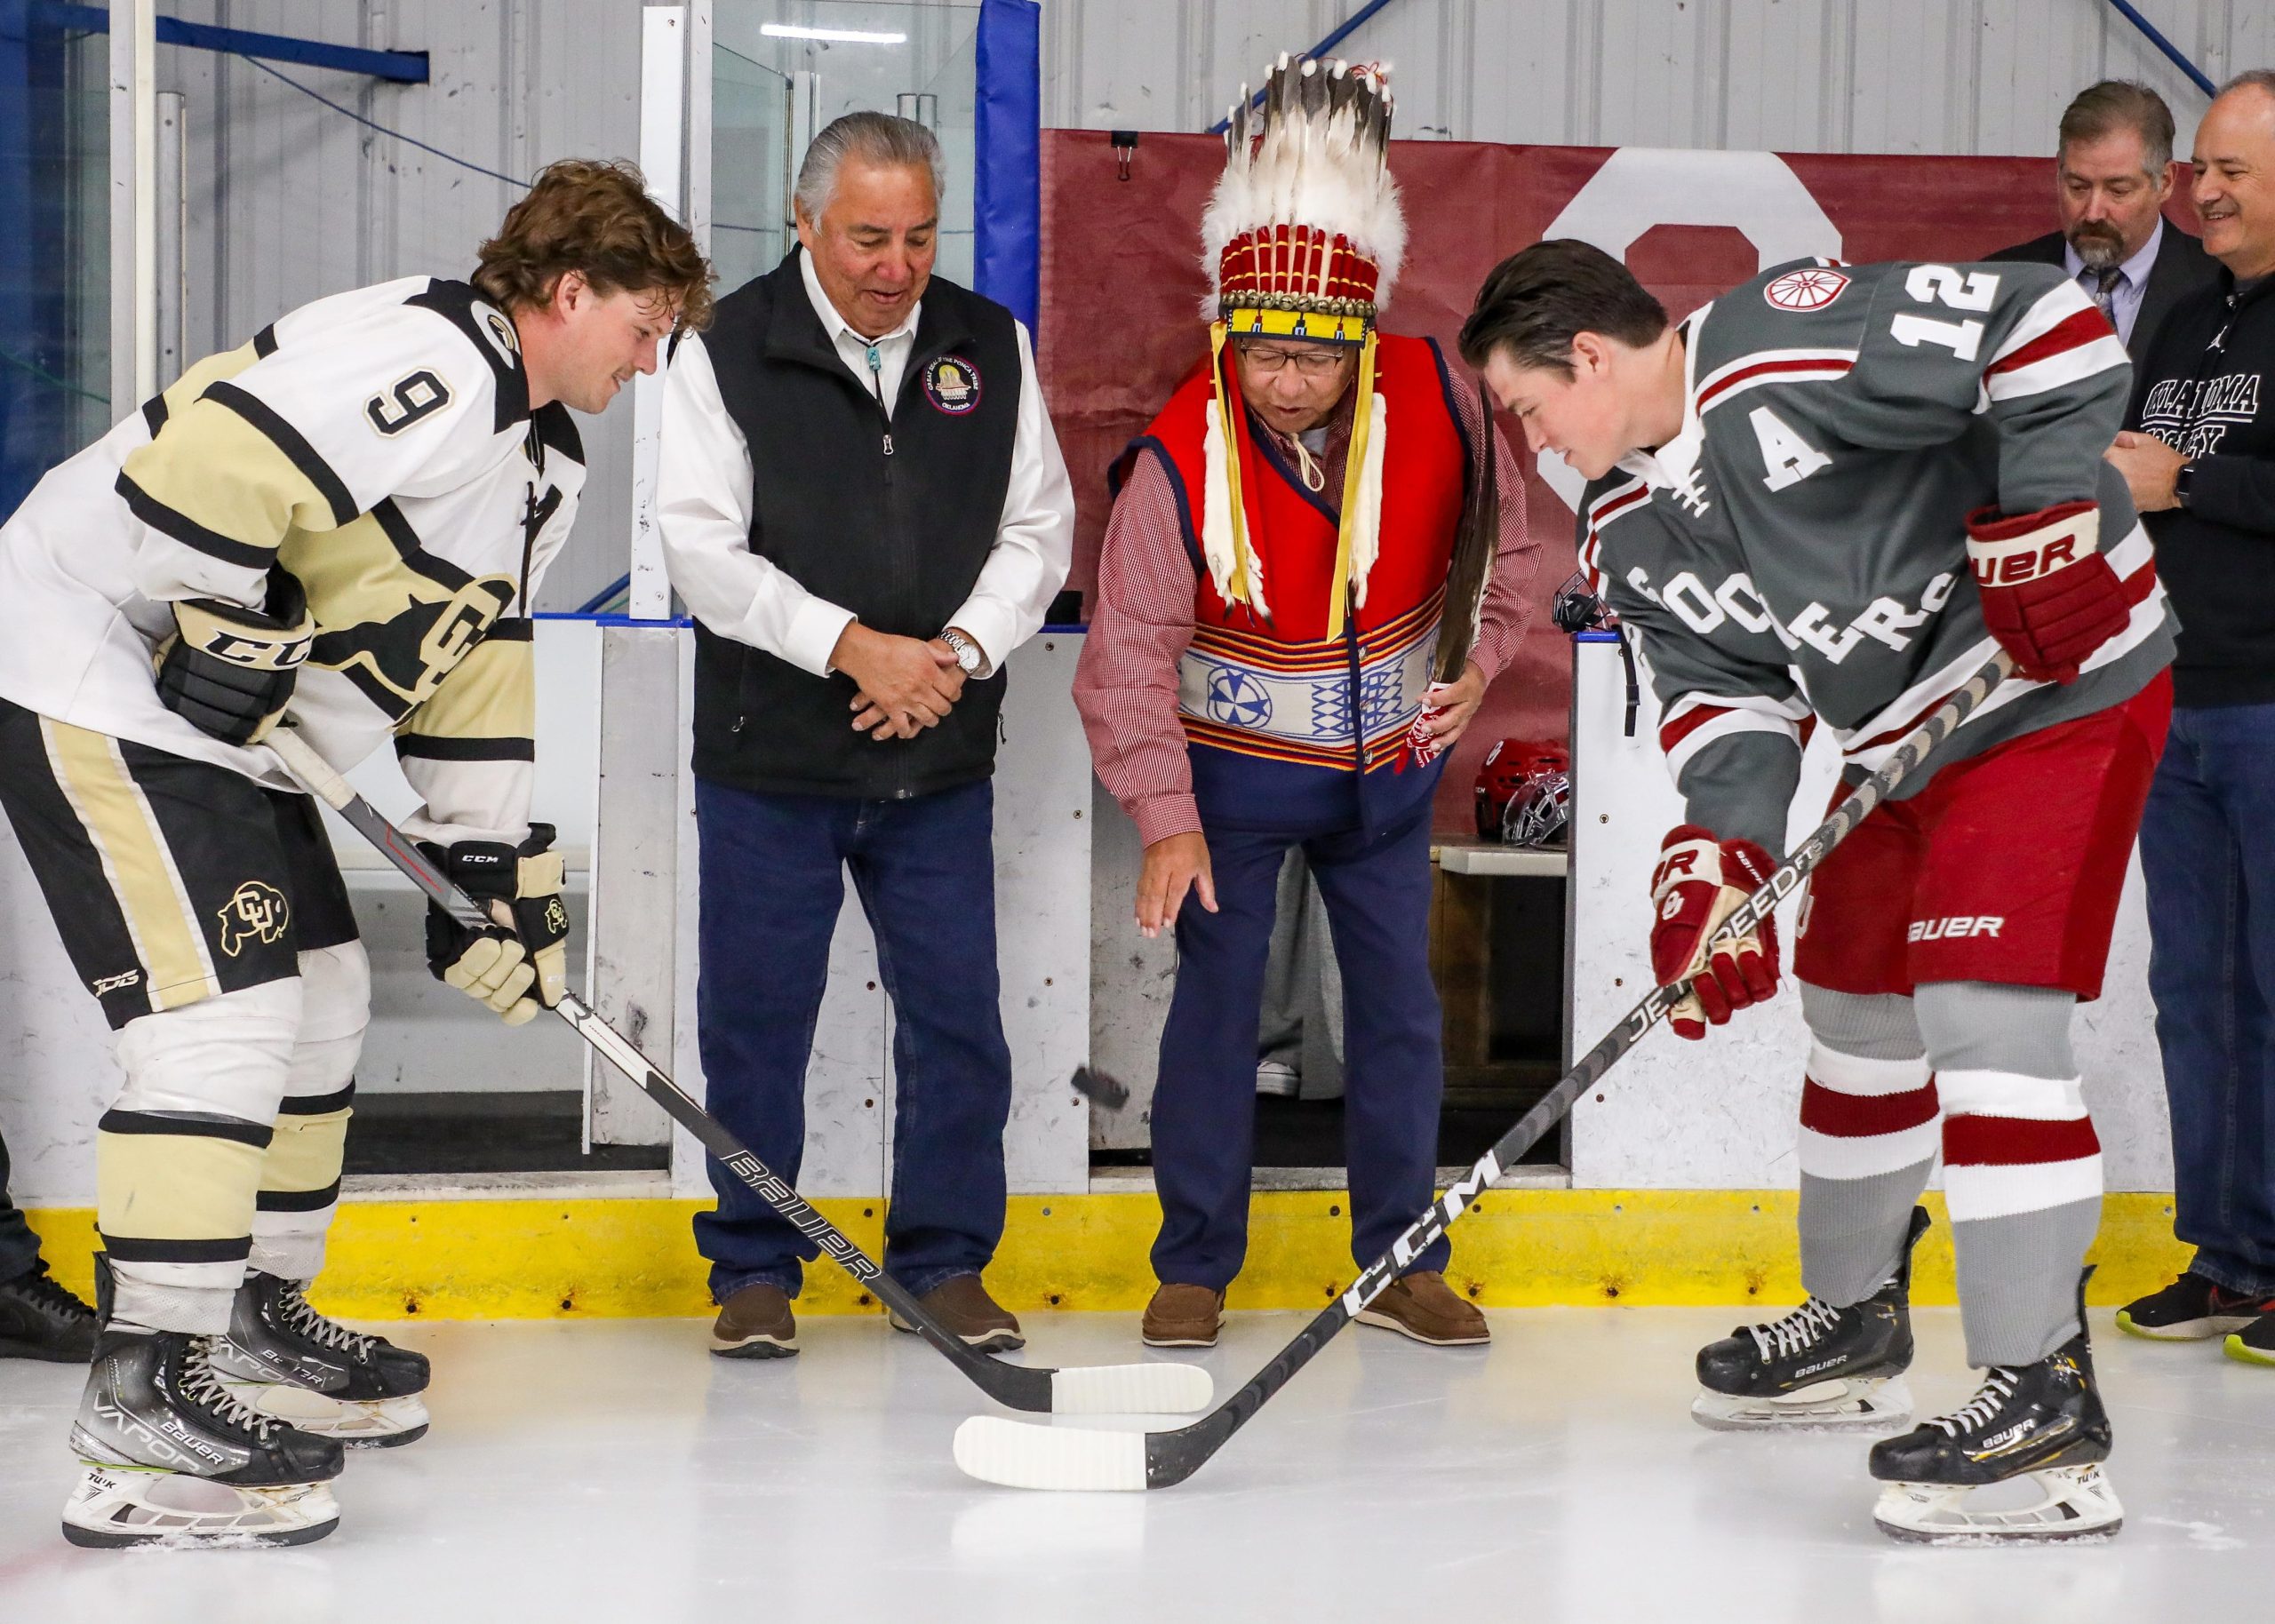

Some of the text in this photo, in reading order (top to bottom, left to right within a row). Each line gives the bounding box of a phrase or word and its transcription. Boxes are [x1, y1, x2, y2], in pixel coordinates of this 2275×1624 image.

[1890, 264, 2000, 362] 12
[363, 366, 456, 439] 9
[1749, 406, 1833, 492] A
[1969, 533, 2076, 585] UER
[204, 627, 313, 668] CC
[1908, 916, 2005, 944] AUER
[719, 1150, 882, 1283] BAUER
[1342, 1149, 1502, 1318] CCM
[1795, 1354, 1848, 1378] BAUER
[160, 1421, 224, 1465] BAUER
[1982, 1418, 2035, 1449] BAUER
